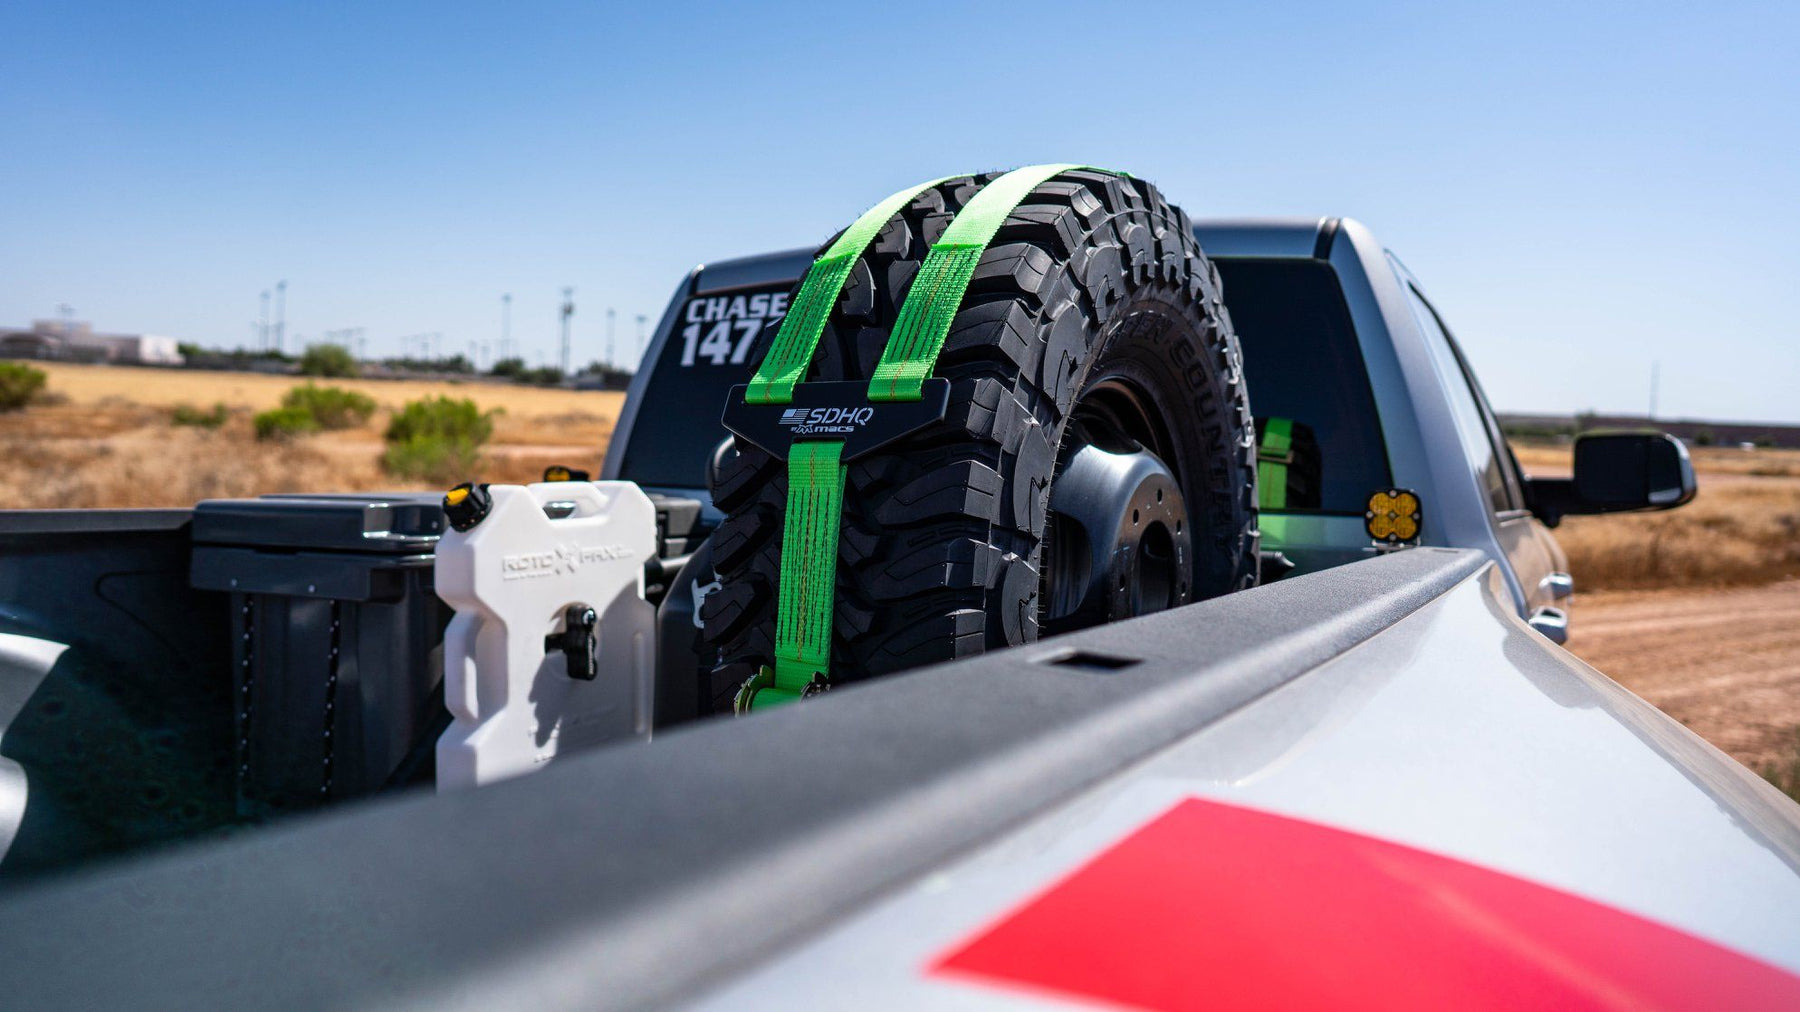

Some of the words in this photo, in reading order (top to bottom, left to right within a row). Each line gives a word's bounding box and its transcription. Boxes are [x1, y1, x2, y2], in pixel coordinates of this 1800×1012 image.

[686, 292, 789, 322] CHASE
[680, 319, 763, 367] 147
[806, 407, 874, 426] SDHQ
